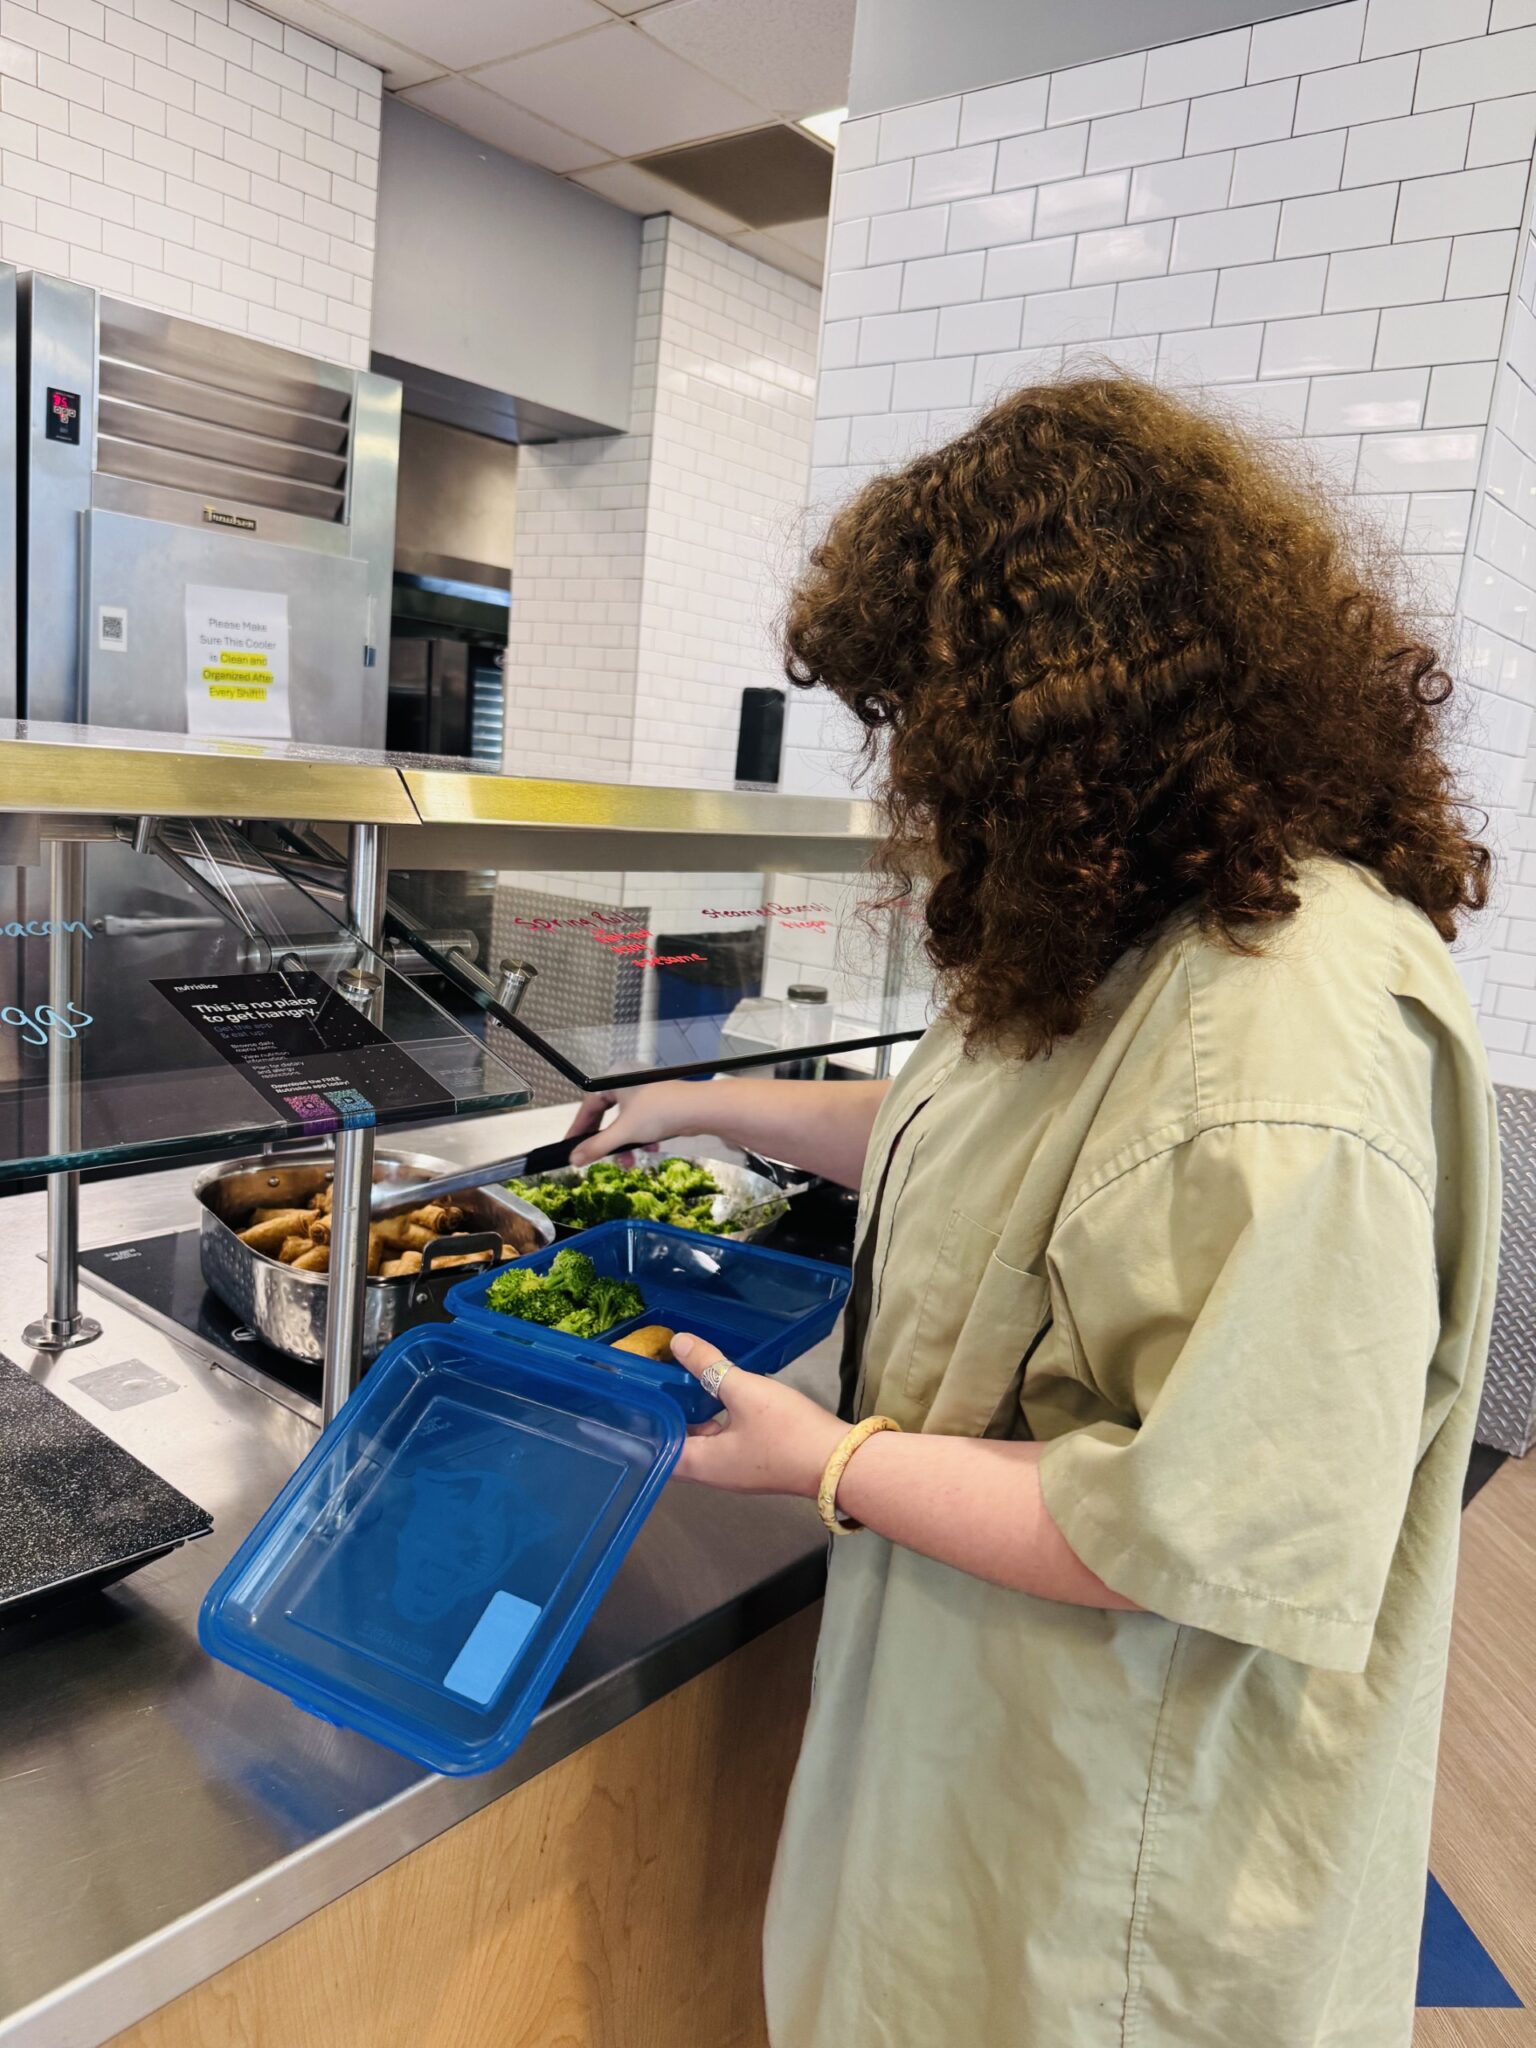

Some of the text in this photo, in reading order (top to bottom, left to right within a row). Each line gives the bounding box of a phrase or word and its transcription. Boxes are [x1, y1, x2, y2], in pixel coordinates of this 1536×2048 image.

[208, 618, 268, 632] Please Make
[200, 635, 277, 649] Sure This Cooler
[220, 653, 249, 664] Clean
[249, 655, 267, 666] and
[203, 670, 274, 683] Organized After
[209, 687, 237, 699] Every
[0, 920, 94, 940] acon
[514, 916, 600, 931] Spring
[173, 983, 219, 992] nutrislice
[191, 997, 318, 1014] This is no place
[202, 1007, 320, 1024] to get hangry.
[0, 1001, 94, 1046] ggs
[271, 1081, 309, 1089] Download
[275, 1085, 314, 1093] Nutrislice
[326, 1080, 350, 1088] today!
